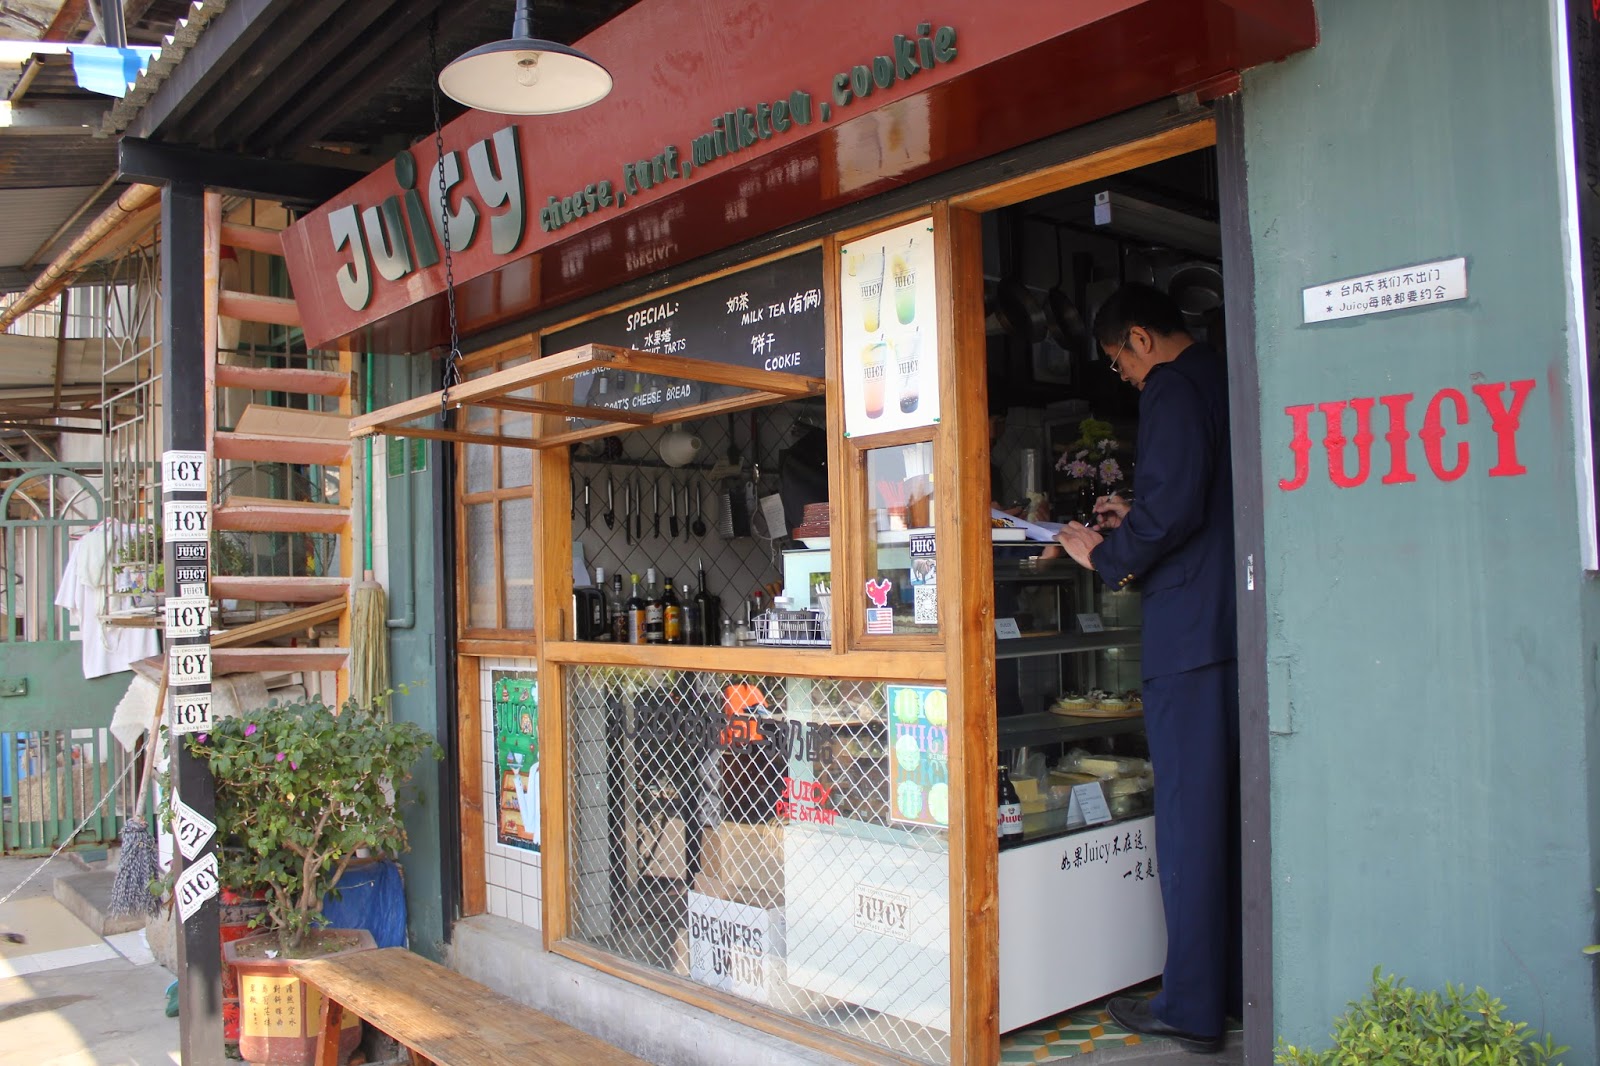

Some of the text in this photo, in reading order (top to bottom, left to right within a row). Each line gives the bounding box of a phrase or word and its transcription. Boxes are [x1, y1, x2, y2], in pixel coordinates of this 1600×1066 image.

[832, 21, 958, 107] cookie
[328, 124, 527, 312] Juicy
[860, 282, 882, 298] JUICY
[894, 272, 916, 288] JUICY
[1340, 268, 1441, 297] 台风天我们不出门
[726, 292, 749, 314] 奶茶
[1339, 285, 1447, 312] Juicy每晚都要约会
[626, 302, 680, 331] SPECIAL:
[741, 308, 764, 326] MILK
[768, 302, 786, 318] TEA
[644, 327, 672, 347] 水果塔
[663, 338, 687, 355] TARTS
[751, 332, 776, 355] 饼干
[764, 352, 801, 371] COOKIE
[864, 365, 884, 379] JUICY
[899, 359, 919, 375] JUICY
[632, 391, 662, 408] CHEESE
[666, 384, 691, 401] BREAD
[1278, 379, 1536, 491] JUICY
[178, 546, 206, 557] JUICY
[178, 569, 206, 580] JUICY
[183, 586, 204, 596] JUICY
[781, 776, 832, 806] JUICY
[1122, 857, 1156, 882] 一定是
[856, 893, 908, 930] JUICY
[691, 911, 763, 957] BREWERS
